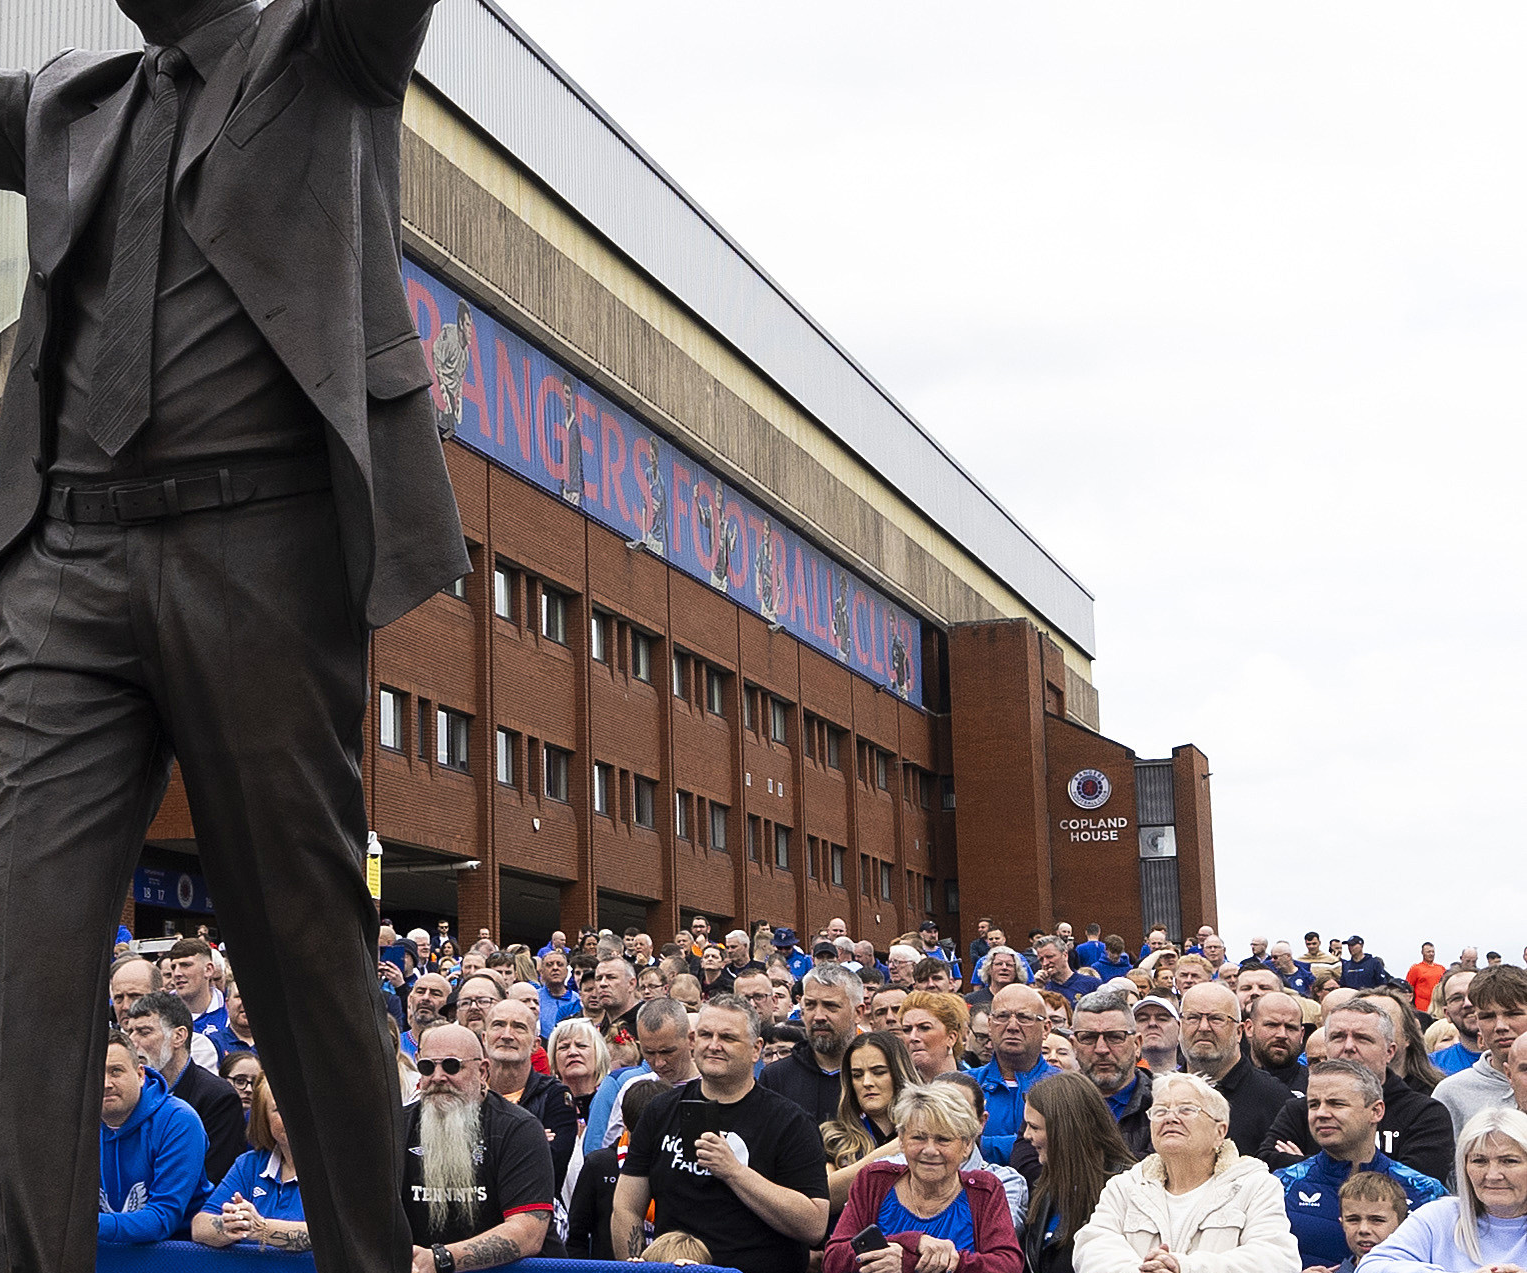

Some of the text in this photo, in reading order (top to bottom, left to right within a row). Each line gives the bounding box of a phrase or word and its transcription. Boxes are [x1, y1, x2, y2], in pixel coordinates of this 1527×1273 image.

[406, 278, 654, 535] RANGERS
[852, 590, 916, 694] CLUB
[1059, 817, 1128, 830] COPLAND
[1070, 830, 1119, 842] HOUSE
